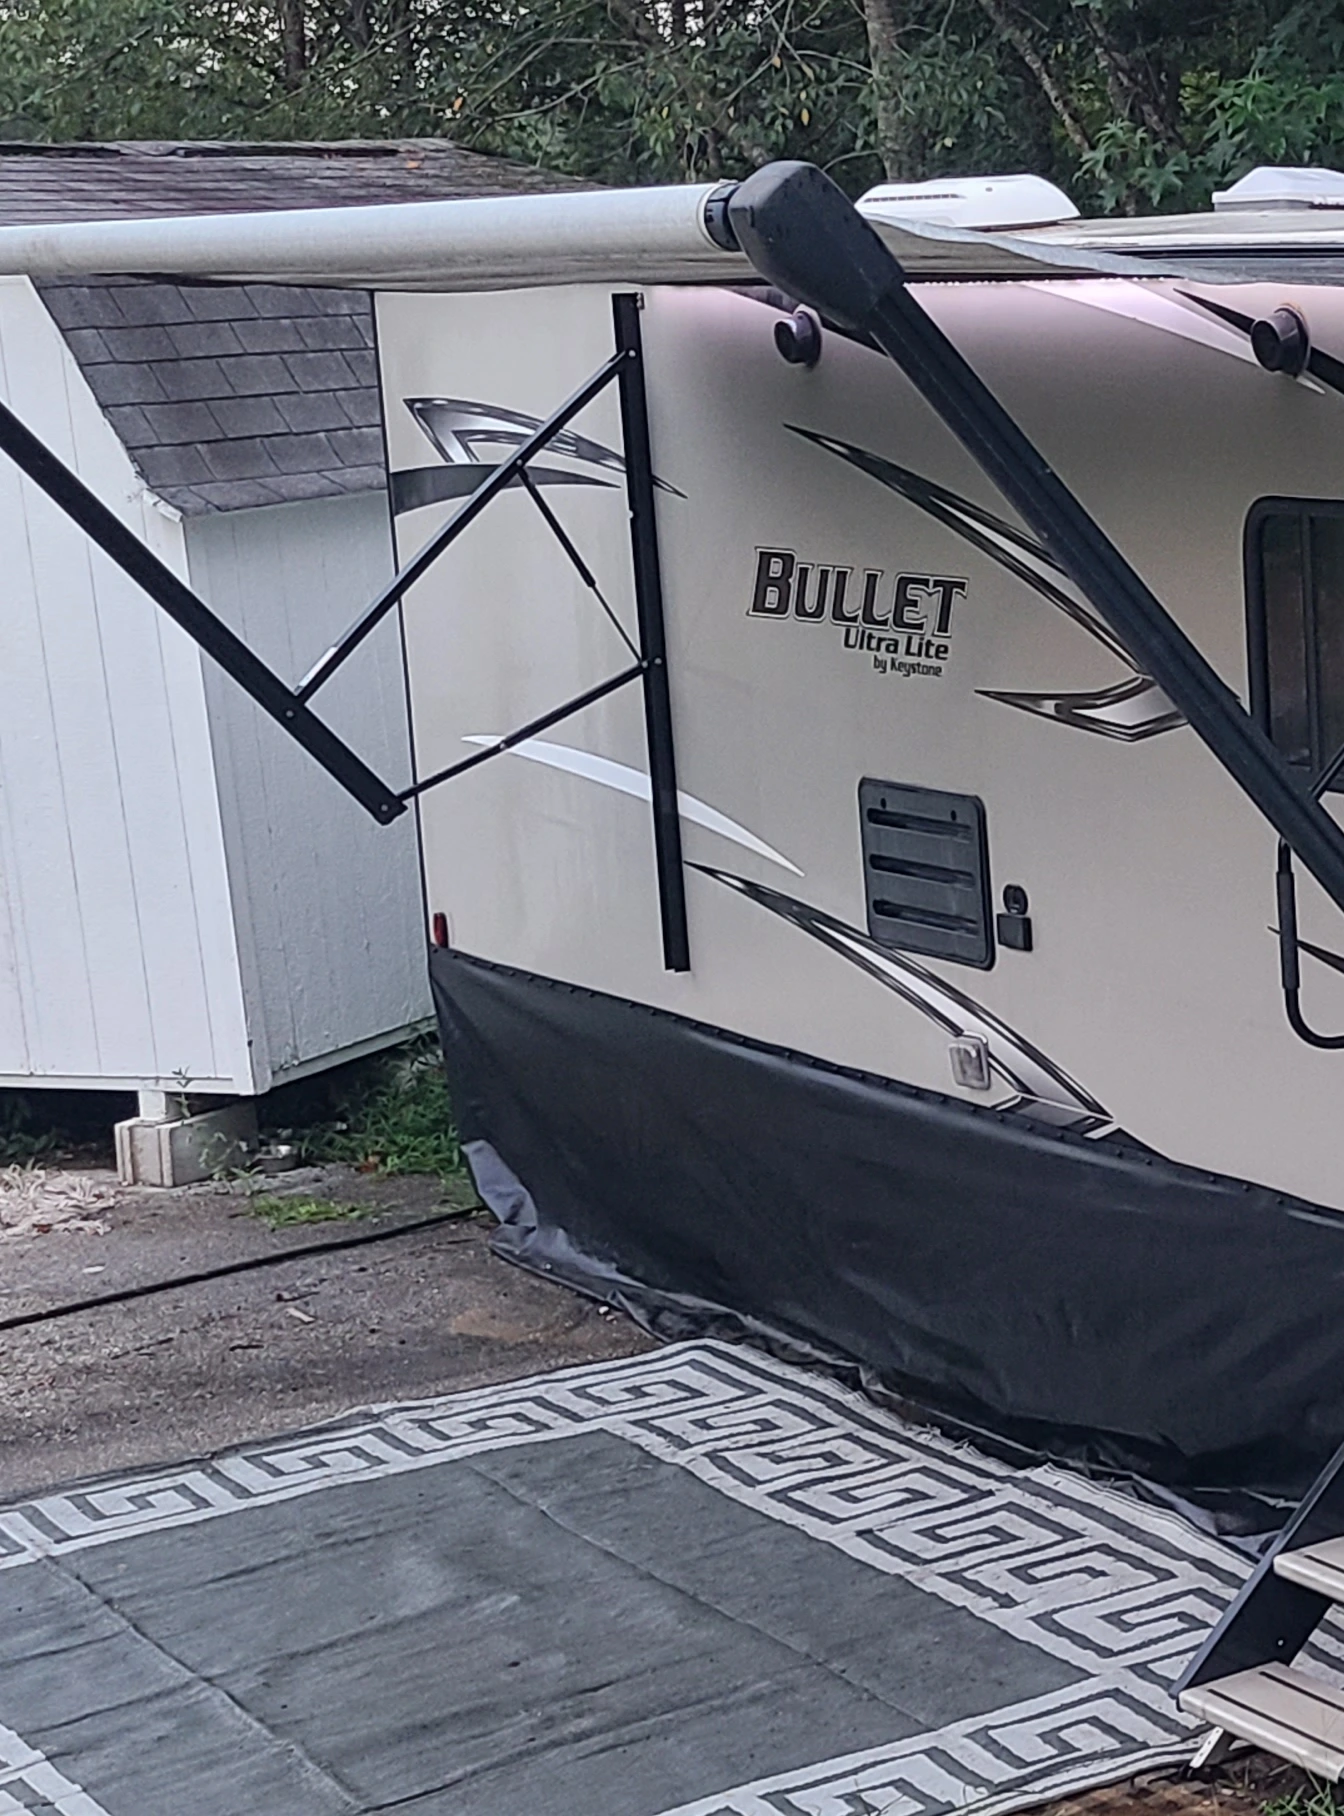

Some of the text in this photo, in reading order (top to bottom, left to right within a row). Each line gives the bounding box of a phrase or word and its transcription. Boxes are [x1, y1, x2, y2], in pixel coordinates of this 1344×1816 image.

[747, 546, 969, 638] BULLET
[843, 628, 950, 661] Ultra Lite
[873, 655, 943, 678] by Keystone
